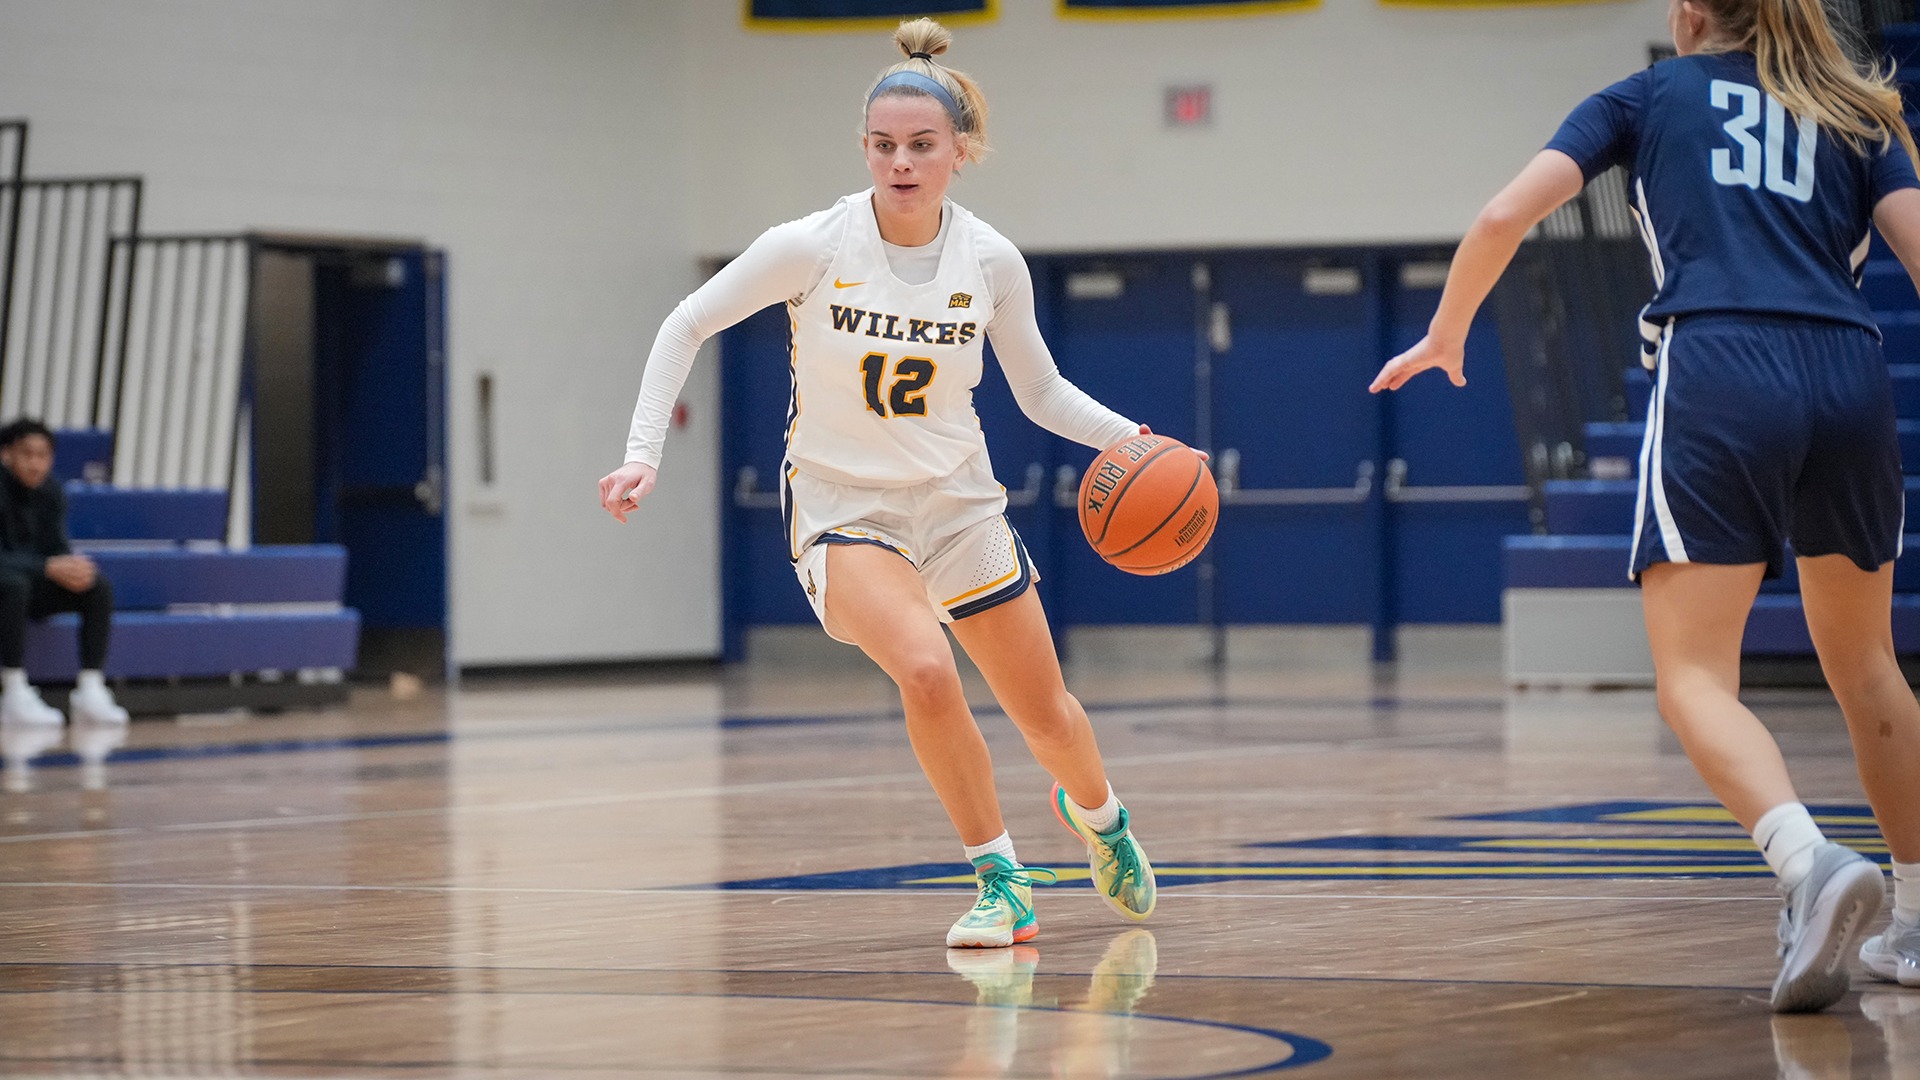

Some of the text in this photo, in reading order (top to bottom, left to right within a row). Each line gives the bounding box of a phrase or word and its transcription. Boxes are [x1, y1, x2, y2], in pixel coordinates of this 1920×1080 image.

[1710, 79, 1818, 202] 30
[830, 304, 976, 345] WILKES
[950, 299, 970, 307] MAC
[859, 351, 937, 419] 12
[1087, 436, 1163, 515] THE ROCK
